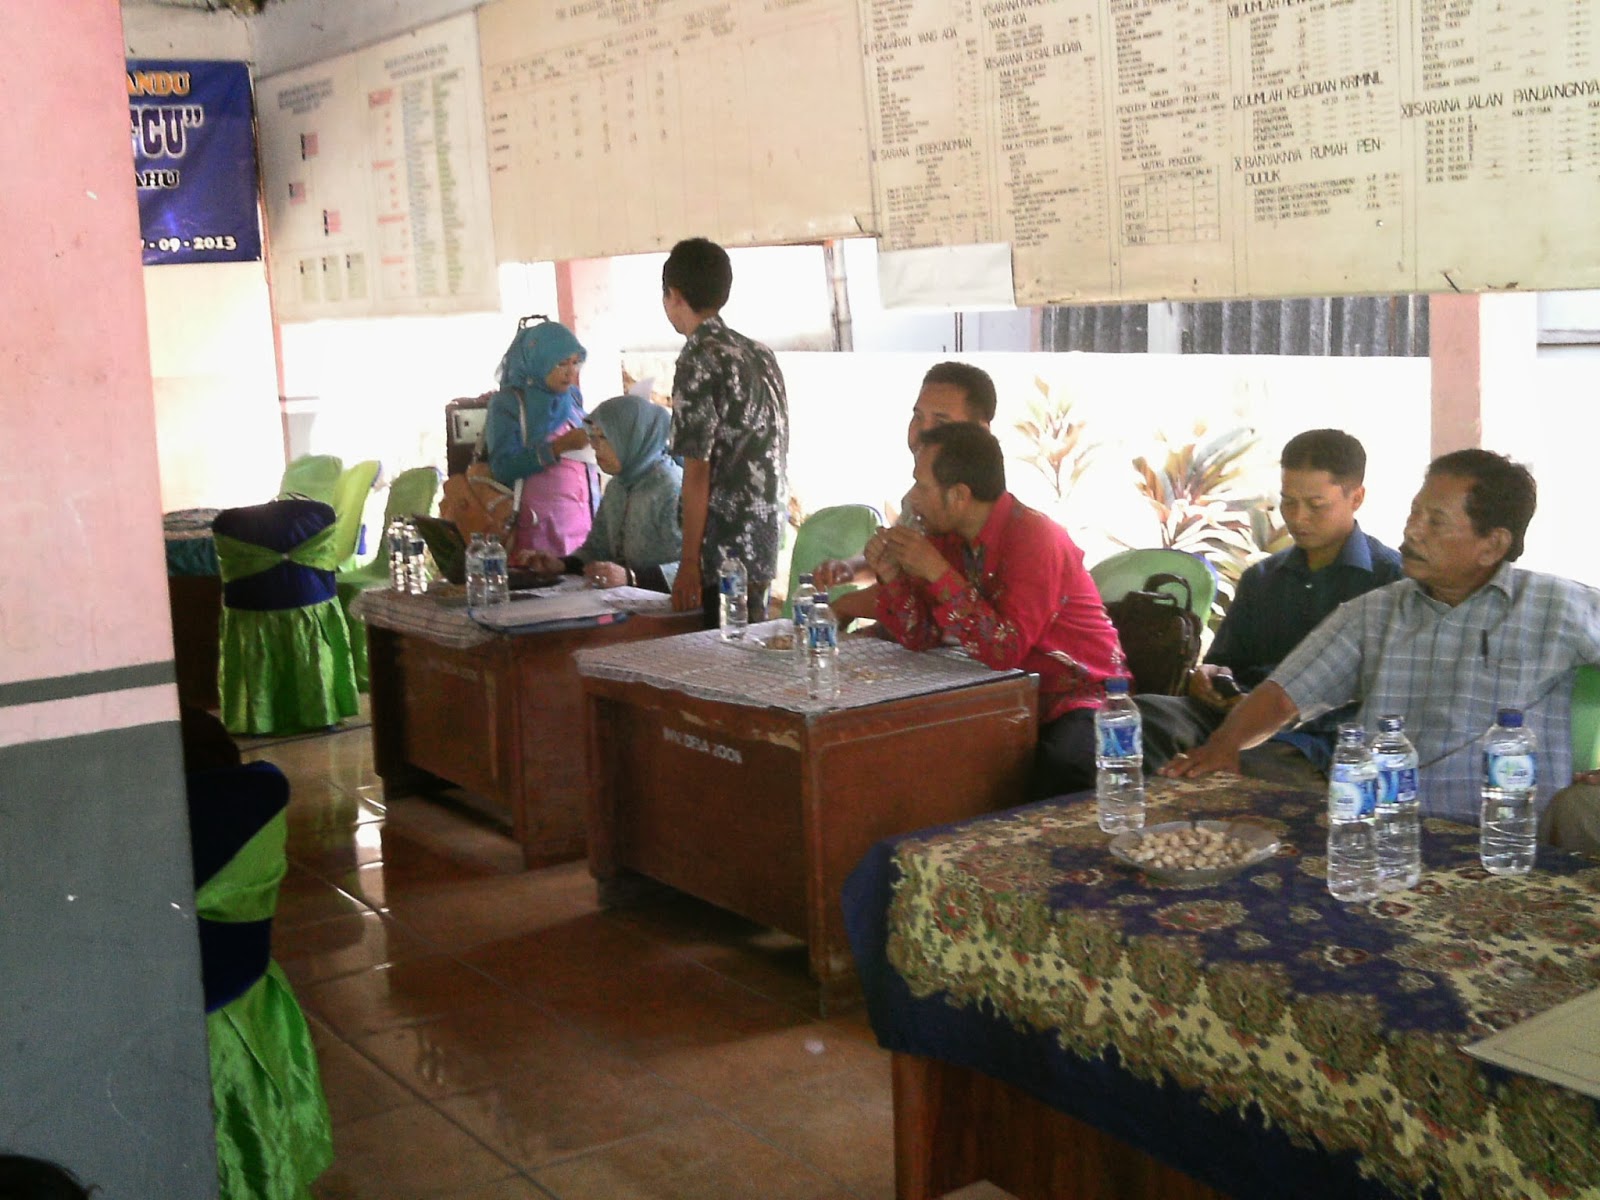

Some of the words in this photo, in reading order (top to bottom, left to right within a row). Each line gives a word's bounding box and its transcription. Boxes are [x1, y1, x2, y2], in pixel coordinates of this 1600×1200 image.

[1243, 88, 1283, 107] JUMLAH
[1286, 79, 1337, 99] KEJADIAN
[1413, 99, 1461, 117] SARANA
[1466, 92, 1504, 110] JALAN
[1513, 79, 1600, 104] PANJANGNYA
[1234, 156, 1243, 172] X
[1244, 150, 1302, 170] BANYAKNYA
[1310, 142, 1348, 160] RUMAH
[1244, 170, 1281, 187] DUDUK
[193, 236, 237, 251] 2013
